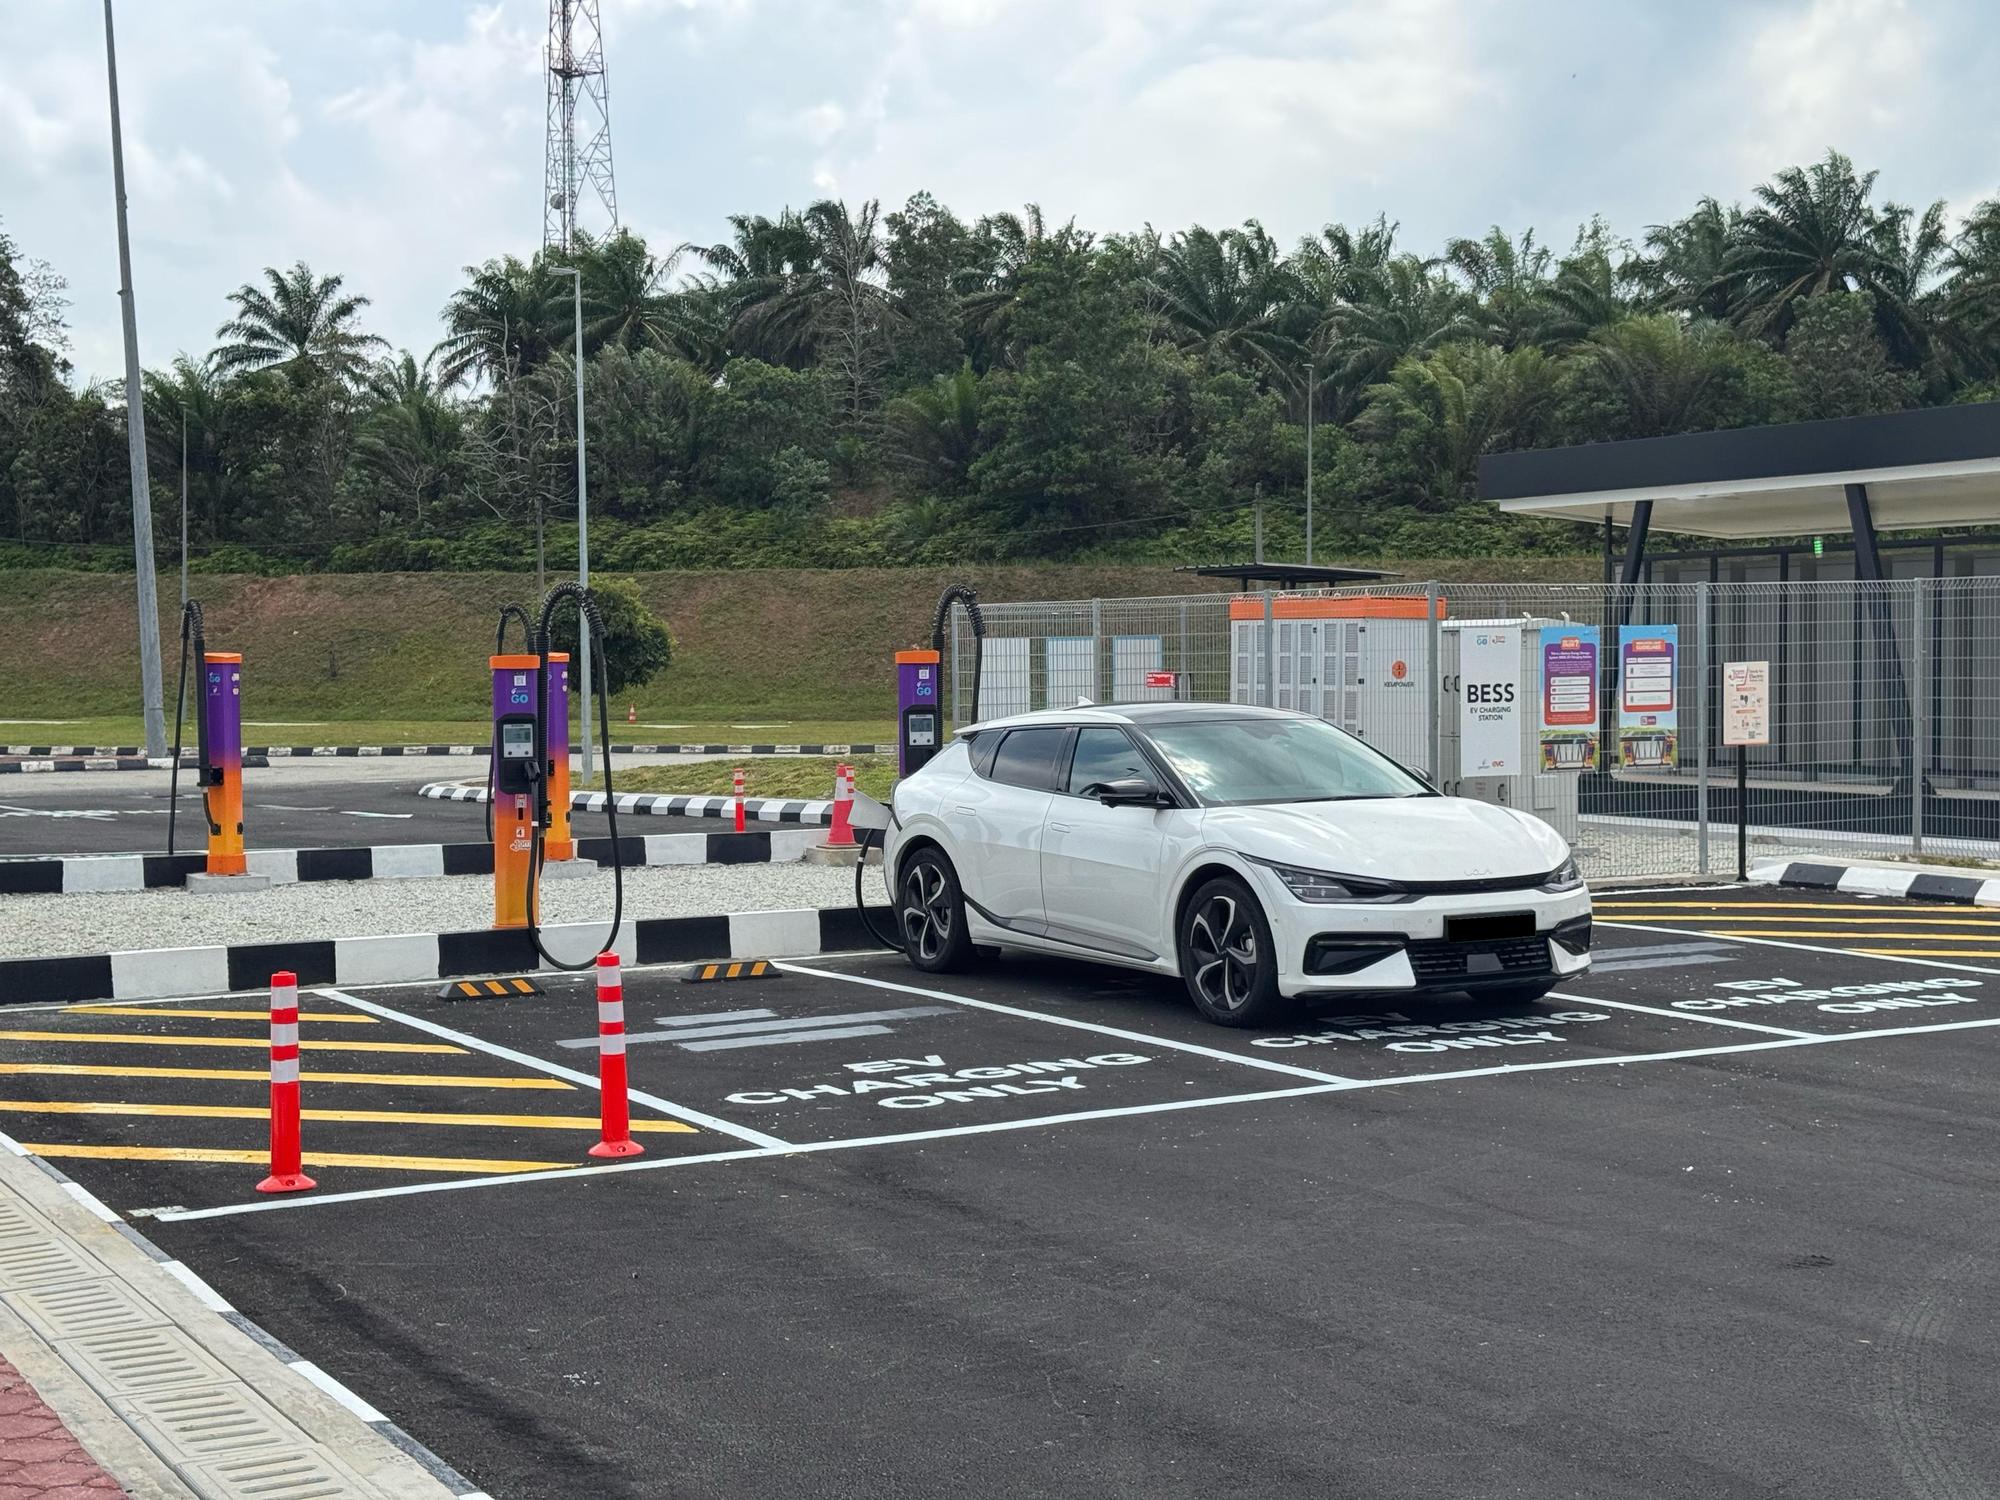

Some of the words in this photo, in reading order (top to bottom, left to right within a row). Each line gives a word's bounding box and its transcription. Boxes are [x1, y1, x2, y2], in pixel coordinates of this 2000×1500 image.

[511, 694, 528, 704] GO
[916, 687, 932, 696] GO
[1467, 683, 1514, 703] BESS
[1479, 706, 1511, 714] CHARGING
[1671, 977, 1984, 1010] CHARGING
[1713, 977, 1802, 990] EV
[1817, 993, 1978, 1014] ONLY
[1250, 1011, 1611, 1048] CHARGING
[1385, 1030, 1567, 1053] ONLY
[842, 1054, 946, 1073] EV
[724, 1052, 1152, 1104] CHARGING
[877, 1075, 1086, 1109] ONLY
